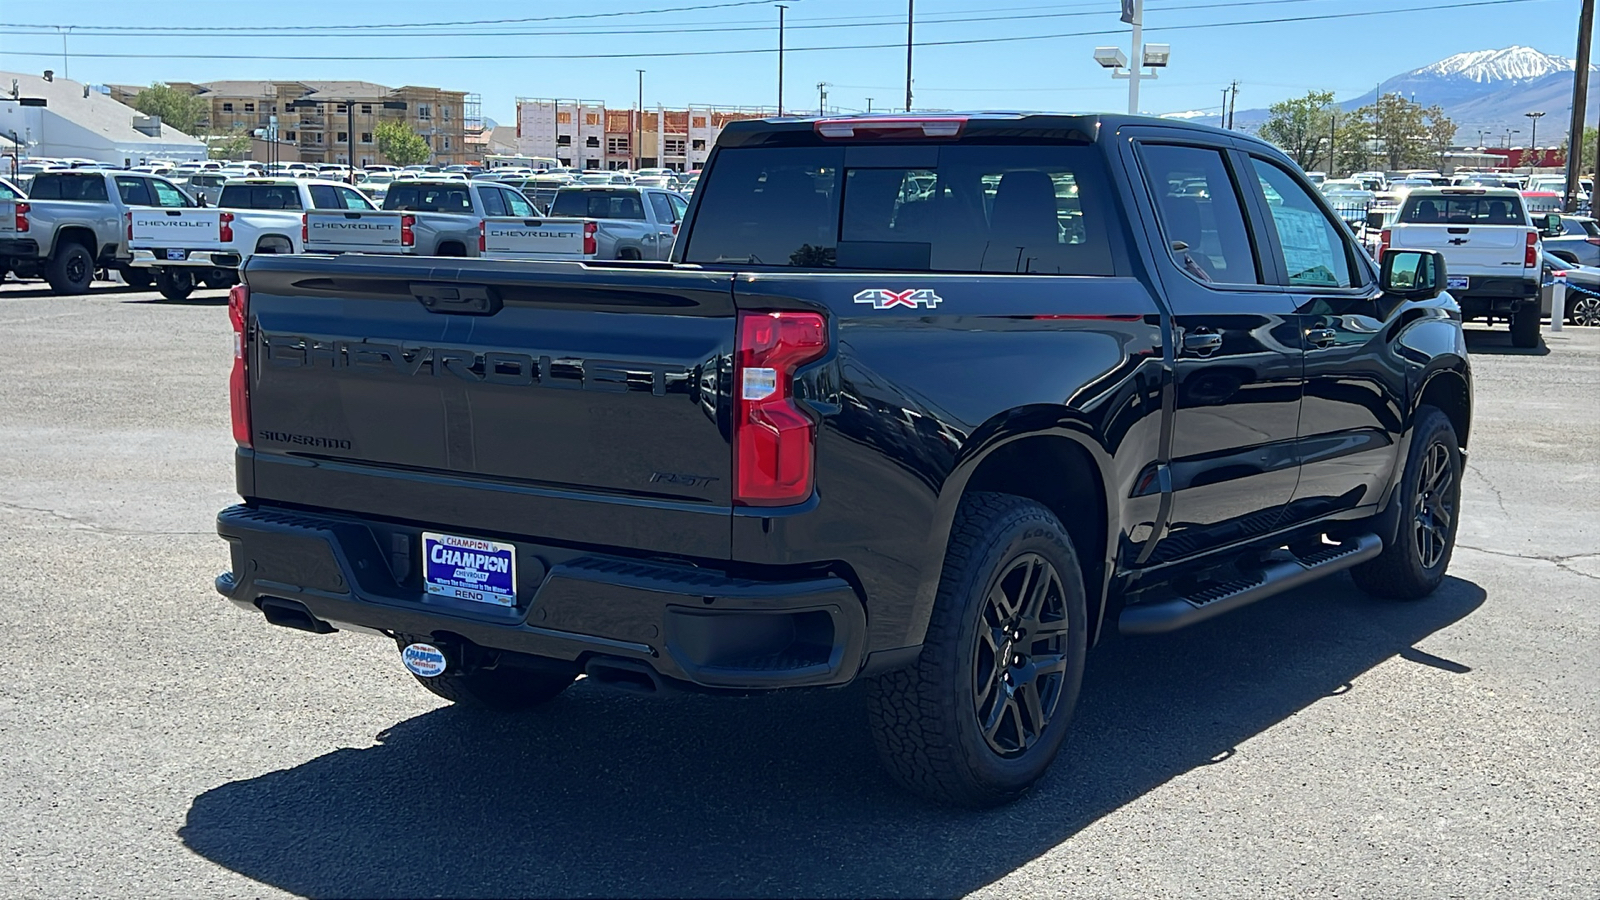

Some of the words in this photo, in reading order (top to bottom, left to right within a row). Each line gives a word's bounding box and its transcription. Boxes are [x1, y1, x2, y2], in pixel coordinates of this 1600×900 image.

[313, 222, 394, 230] CHEVROLET
[490, 230, 576, 238] CHEVROLET
[265, 335, 689, 397] CHEVROLET
[259, 430, 351, 450] SILVERADO
[649, 472, 720, 488] RST
[446, 537, 489, 550] CHAMPION
[431, 544, 509, 573] CHAMPION
[456, 569, 487, 580] CHEVROLET
[455, 590, 483, 601] RENO
